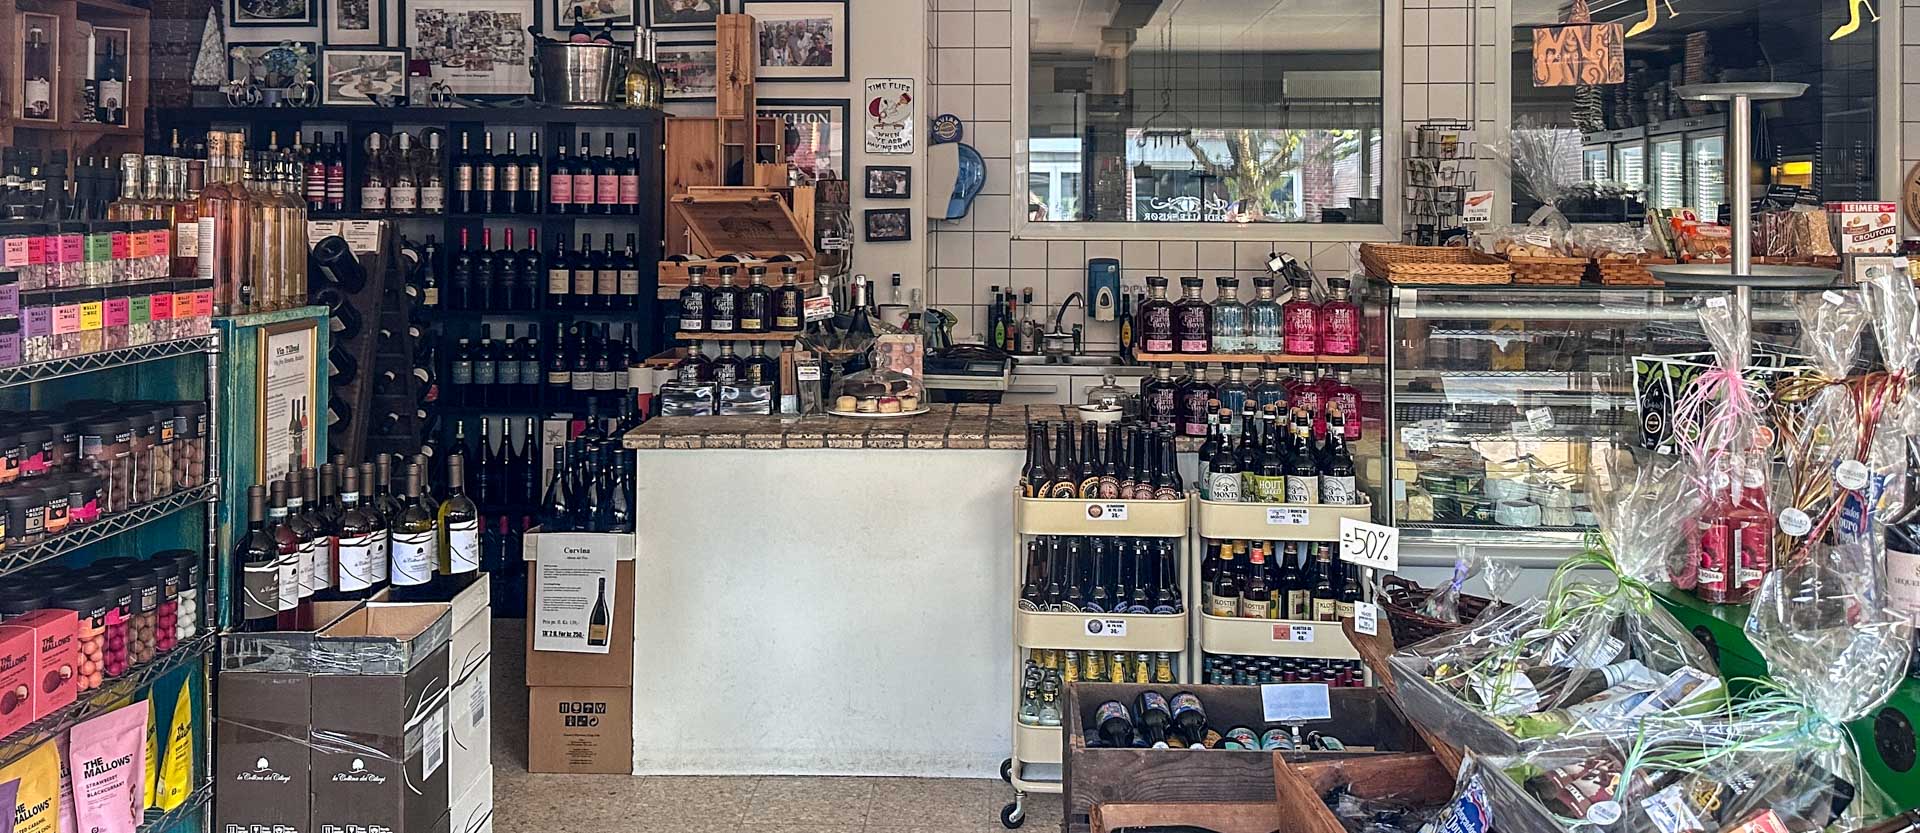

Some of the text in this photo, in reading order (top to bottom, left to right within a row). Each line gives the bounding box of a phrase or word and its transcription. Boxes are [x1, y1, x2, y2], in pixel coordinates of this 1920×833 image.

[868, 82, 910, 92] TIME FLIES
[934, 117, 958, 130] CAVIAR
[1854, 227, 1895, 241] CROUTONS
[1259, 480, 1282, 489] HOUT
[42, 635, 54, 644] THE
[42, 636, 71, 654] MALLOWS
[84, 757, 104, 770] THE
[84, 756, 131, 779] MALLOWS
[86, 774, 118, 789] STRAWBERRY
[87, 781, 125, 798] BLACKCURRANT
[16, 803, 26, 816] HE
